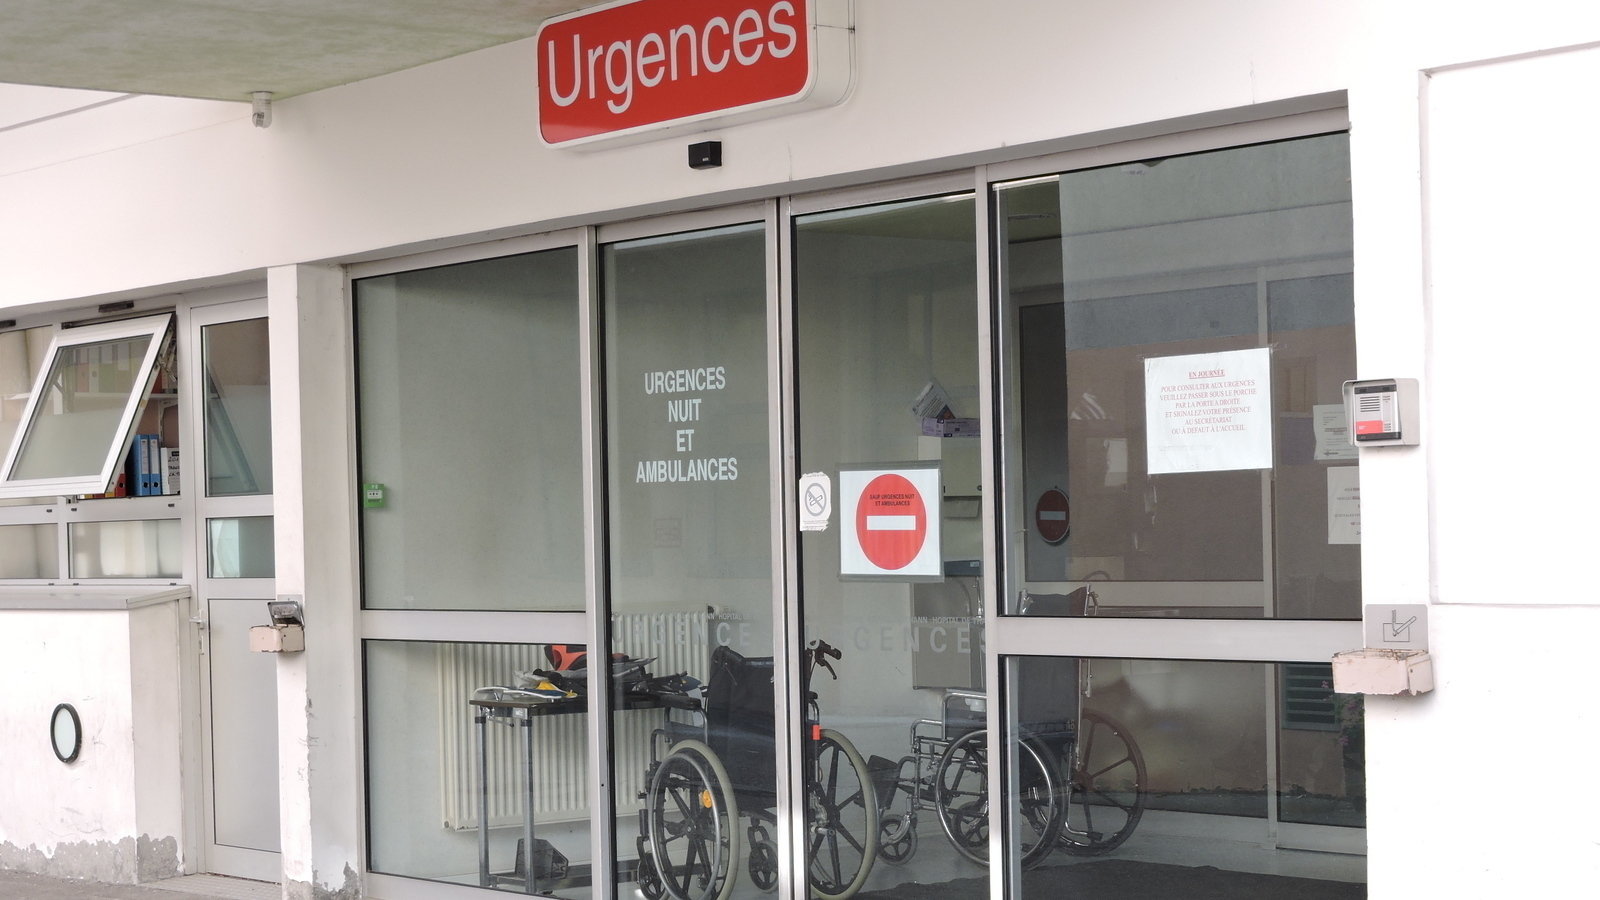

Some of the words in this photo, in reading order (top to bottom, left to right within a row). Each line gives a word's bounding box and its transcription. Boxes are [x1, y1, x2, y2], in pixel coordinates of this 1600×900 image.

[548, 0, 797, 114] Urgences
[644, 366, 726, 395] URGENCES
[1188, 371, 1197, 379] EN
[1160, 393, 1187, 401] VEUILLEZ
[1234, 388, 1256, 396] PORCHE
[1177, 384, 1209, 392] CONSULTER
[1224, 380, 1256, 388] URGENCES
[668, 398, 702, 422] NUIT
[1220, 398, 1240, 406] DROITE
[1174, 409, 1202, 417] SIGNALEZ
[1203, 408, 1221, 416] VOTRE
[676, 429, 695, 452] ET
[636, 457, 738, 483] AMBULANCES
